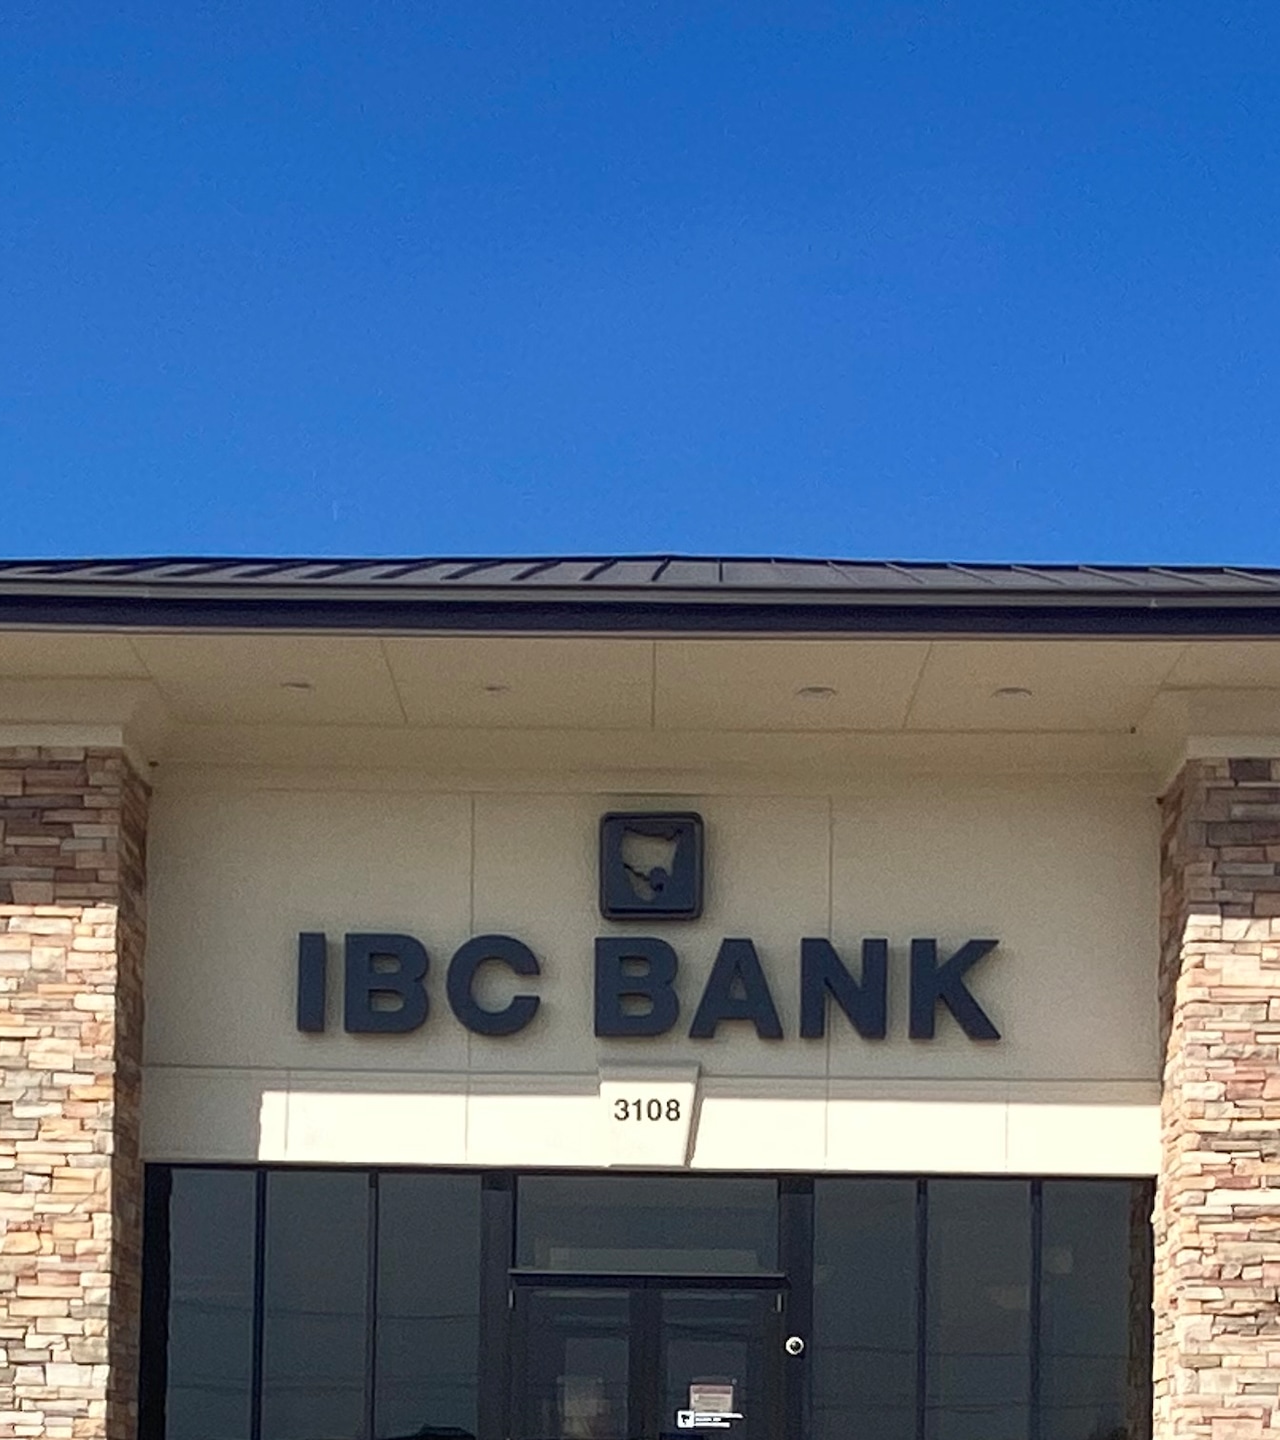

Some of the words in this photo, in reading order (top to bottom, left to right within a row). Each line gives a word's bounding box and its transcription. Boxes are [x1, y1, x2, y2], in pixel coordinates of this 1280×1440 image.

[297, 932, 541, 1036] IBC
[594, 936, 1002, 1040] BANK
[614, 1098, 680, 1121] 3108
